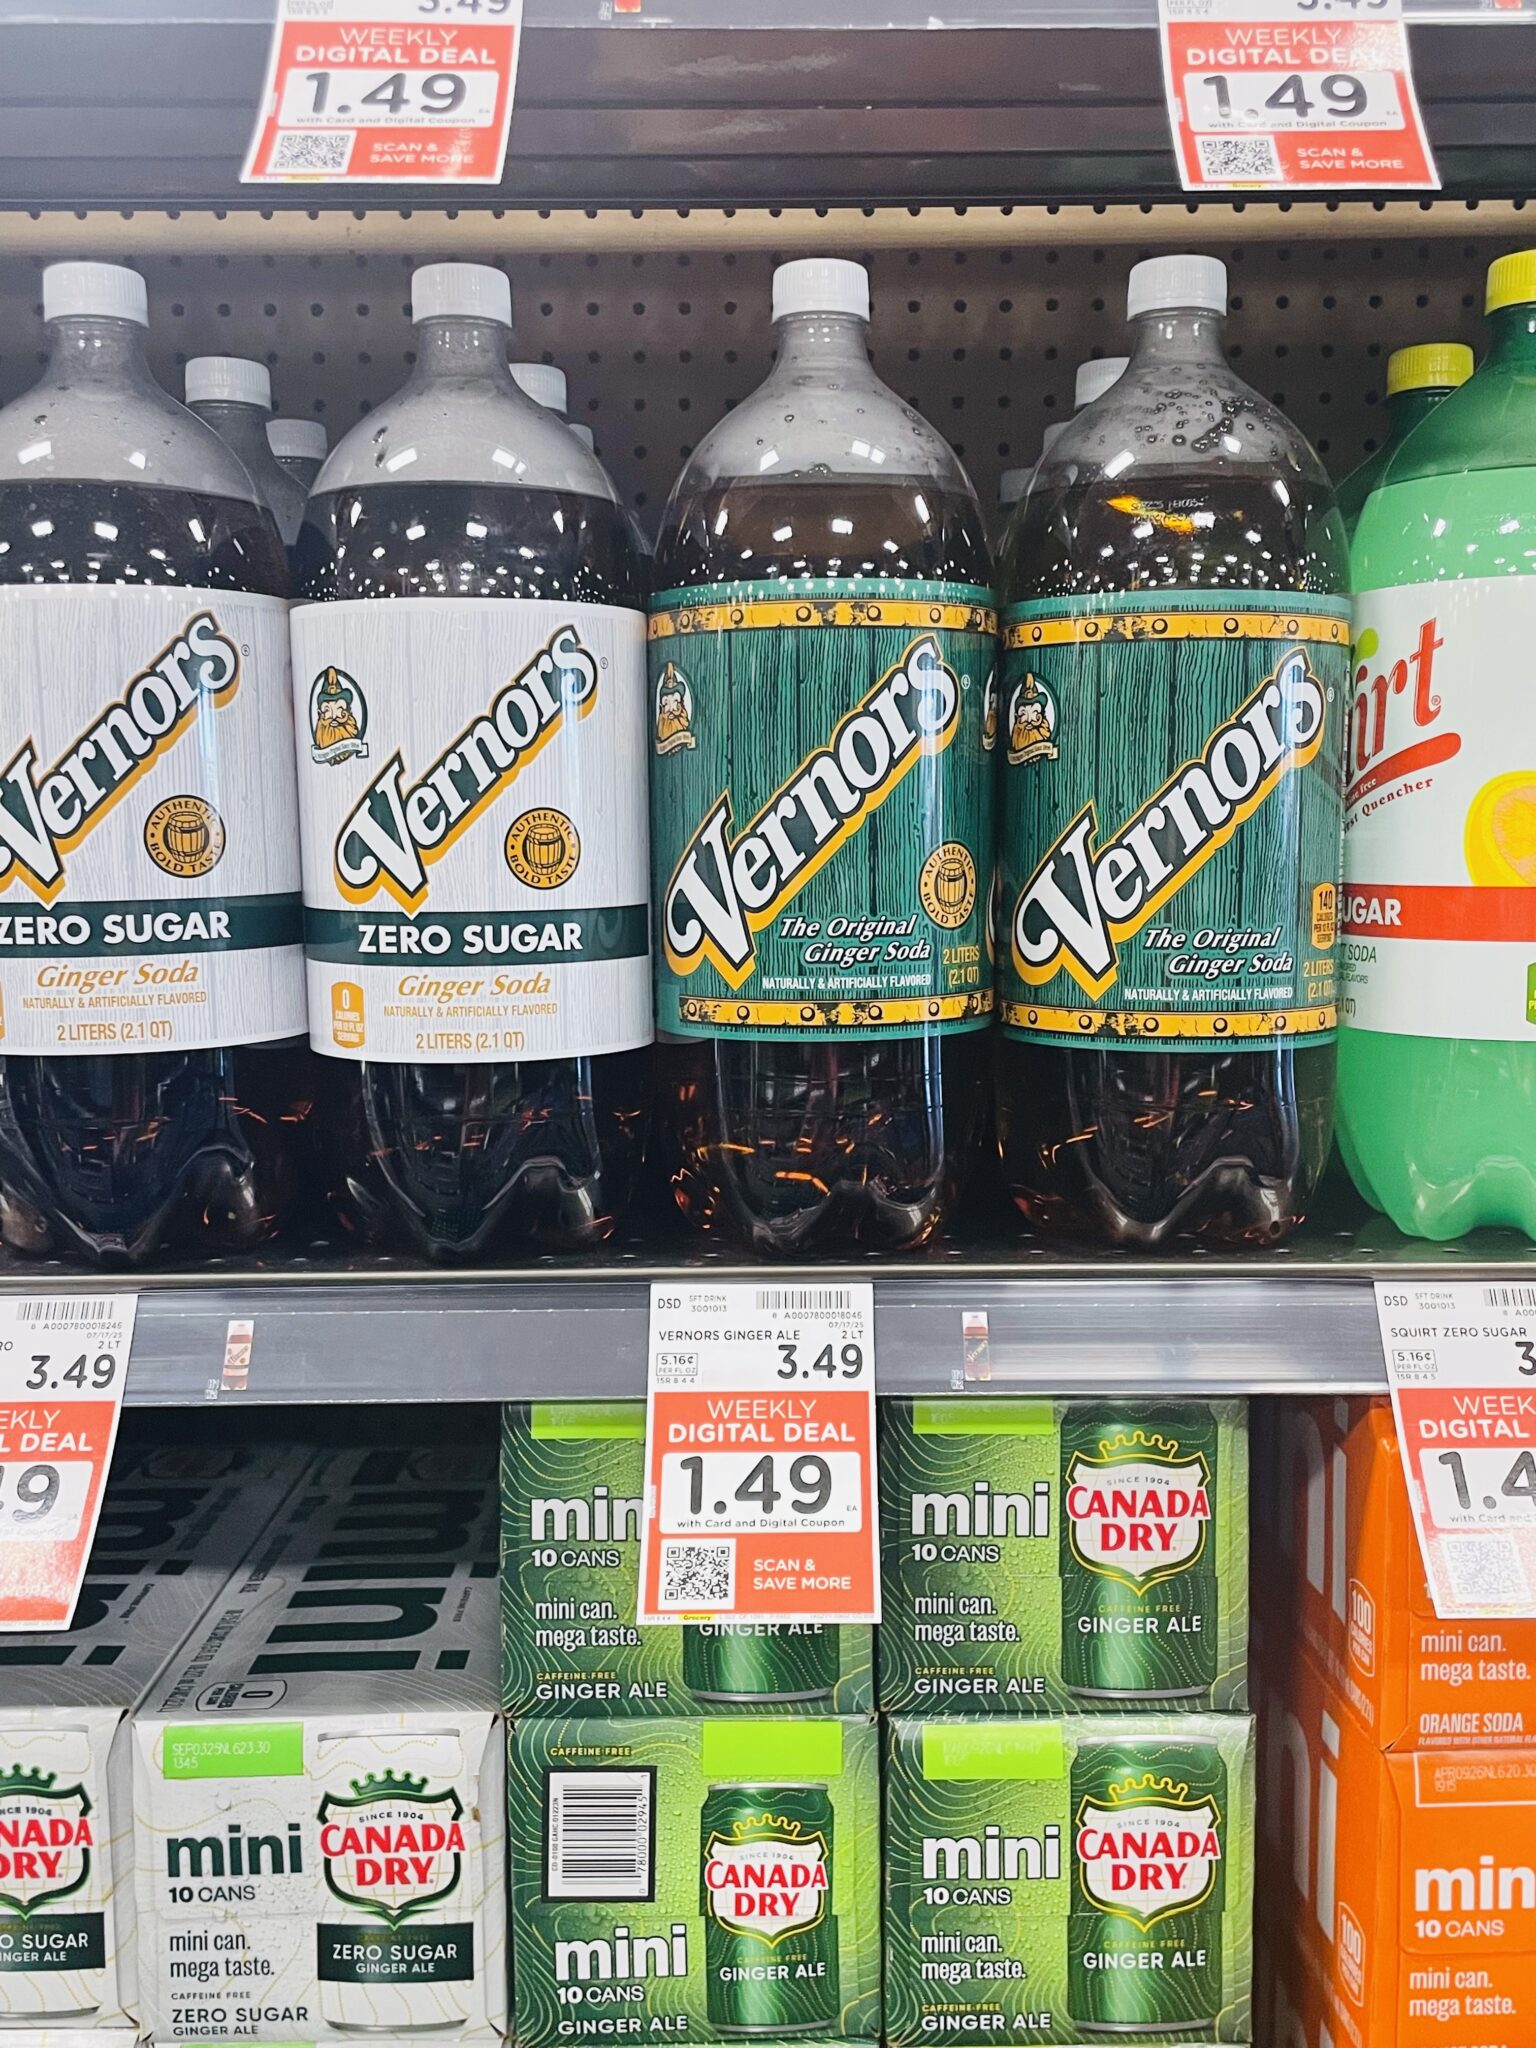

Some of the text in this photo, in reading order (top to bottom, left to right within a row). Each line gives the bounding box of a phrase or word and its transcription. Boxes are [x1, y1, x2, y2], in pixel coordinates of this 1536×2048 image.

[340, 28, 457, 46] WEEKLY
[1226, 28, 1341, 45] WEEKLY
[296, 46, 496, 65] DIGITAL DEAL
[1187, 48, 1300, 66] DIGITAL
[306, 72, 466, 114] 1.49
[1203, 73, 1368, 119] 1.49
[380, 116, 424, 125] Digital
[428, 117, 475, 125] Coupon
[373, 143, 439, 152] SCAN &
[1297, 148, 1363, 158] SCAN &
[370, 154, 474, 164] SAVE MORE
[1300, 160, 1404, 169] SAVE MORE
[337, 628, 597, 895] Vernors
[668, 640, 956, 966] Vernors
[1362, 779, 1433, 817] Quencher
[1014, 652, 1324, 977] Vernors
[1319, 891, 1332, 910] 140
[780, 914, 916, 942] The Original
[358, 922, 584, 955] ZERO SUGAR
[1145, 927, 1280, 953] The Original
[804, 942, 930, 967] Ginger Soda
[943, 946, 980, 965] 2 LITERS
[37, 960, 199, 994] Ginger Soda
[398, 972, 551, 1003] Ginger Soda
[22, 991, 207, 1009] NATURALLY & ARTIFICIALLY FLAVORED
[342, 988, 350, 1010] 0
[384, 1003, 558, 1018] NATURALLY & ARTIFICIALLY FLAVORED
[416, 1032, 525, 1052] 2 LITERS (2.1 QT)
[658, 1299, 681, 1309] DSD
[1384, 1296, 1408, 1306] DSD
[659, 1331, 863, 1341] VERNORS GINGER ALE 2 LT
[1391, 1328, 1527, 1337] SQUIRT ZERO SUGAR
[98, 1341, 121, 1349] 2 LT
[661, 1344, 863, 1379] 5.16¢ 3.49
[1397, 1352, 1431, 1361] 5.16¢
[26, 1354, 115, 1389] 3.49
[707, 1400, 816, 1419] WEEKLY
[668, 1422, 856, 1443] DIGITAL DEAL
[1419, 1419, 1530, 1439] DIGITAL
[20, 1433, 93, 1452] DEAL
[680, 1455, 832, 1515] 1.49
[911, 1481, 1050, 1537] mini
[1068, 1486, 1210, 1519] CANADA
[677, 1519, 845, 1529] with Card and Digital Coupon
[1450, 1515, 1475, 1523] with
[1101, 1523, 1178, 1551] DRY
[532, 1550, 620, 1567] 10 CANS
[912, 1545, 1000, 1562] 10 CANS
[753, 1559, 816, 1572] SCAN &
[753, 1577, 851, 1590] SAVE MORE
[536, 1601, 617, 1619] mini can.
[915, 1594, 997, 1614] mini can.
[1352, 1590, 1371, 1635] 100
[536, 1626, 641, 1651] mega taste.
[915, 1622, 1021, 1646] mega taste.
[1420, 1713, 1523, 1733] ORANGE SODA
[550, 1747, 631, 1756] CAFFEINE FREE
[172, 1757, 198, 1769] 1345
[25, 1806, 52, 1816] 1904
[359, 1811, 423, 1823] SINCE 1904
[1117, 1818, 1181, 1828] SINCE 1904
[320, 1822, 465, 1857] CANADA
[638, 1796, 647, 1872] 78000 02945
[167, 1823, 302, 1877] mini
[355, 1856, 434, 1886] DRY
[706, 1860, 827, 1889] CANADA
[169, 1886, 256, 1903] 10 CANS
[734, 1892, 800, 1917] DRY
[22, 1933, 88, 1949] SUGAR
[170, 1932, 251, 1951] mini can.
[44, 1951, 67, 1961] ALE
[333, 1943, 457, 1960] ZERO SUGAR
[555, 1924, 687, 1981] mini
[1083, 1950, 1206, 1969] GINGER ALE
[720, 1963, 826, 1981] GINGER ALE
[171, 1991, 251, 2000] CAFFEINE FREE
[172, 2006, 308, 2023] ZERO SUGAR
[173, 2025, 258, 2036] GINGER ALE
[558, 2016, 688, 2035] GINGER ALE
